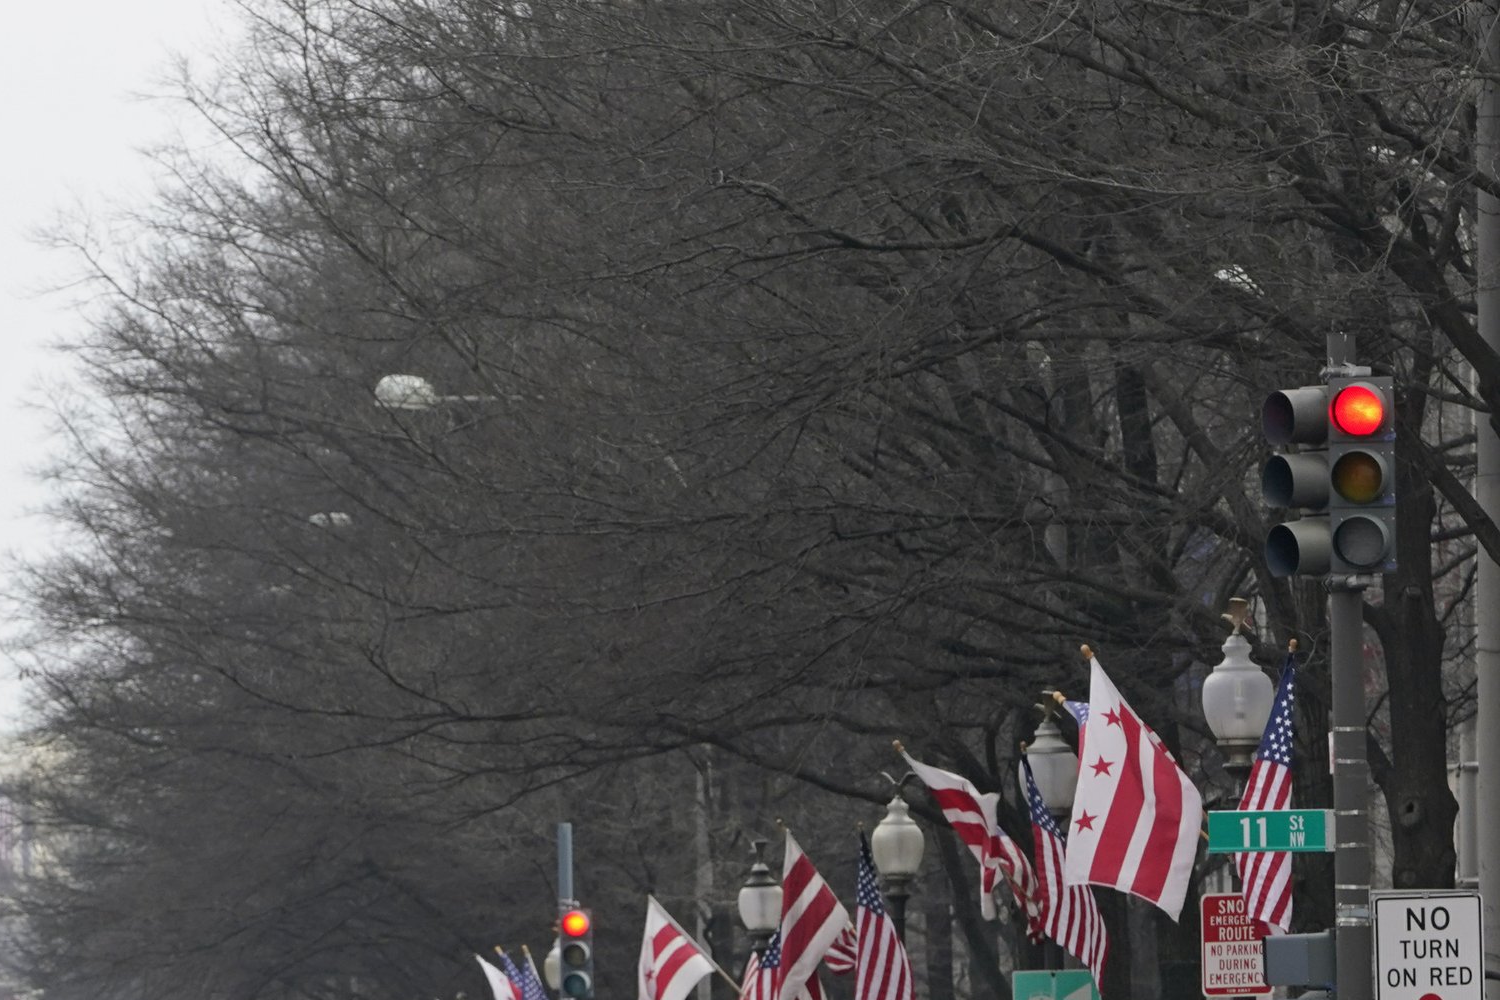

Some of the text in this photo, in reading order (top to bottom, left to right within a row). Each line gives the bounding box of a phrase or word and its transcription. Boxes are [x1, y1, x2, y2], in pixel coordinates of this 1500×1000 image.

[1239, 814, 1304, 848] 11 St
[1289, 831, 1306, 848] NW
[1218, 899, 1245, 914] SNO
[1210, 915, 1252, 926] EMERGEN
[1406, 906, 1450, 931] NO
[1219, 926, 1256, 941] ROUTE
[1211, 944, 1222, 956] NO
[1399, 938, 1459, 959] TURN
[1219, 958, 1257, 971] DURING
[1387, 966, 1473, 988] ON RED
